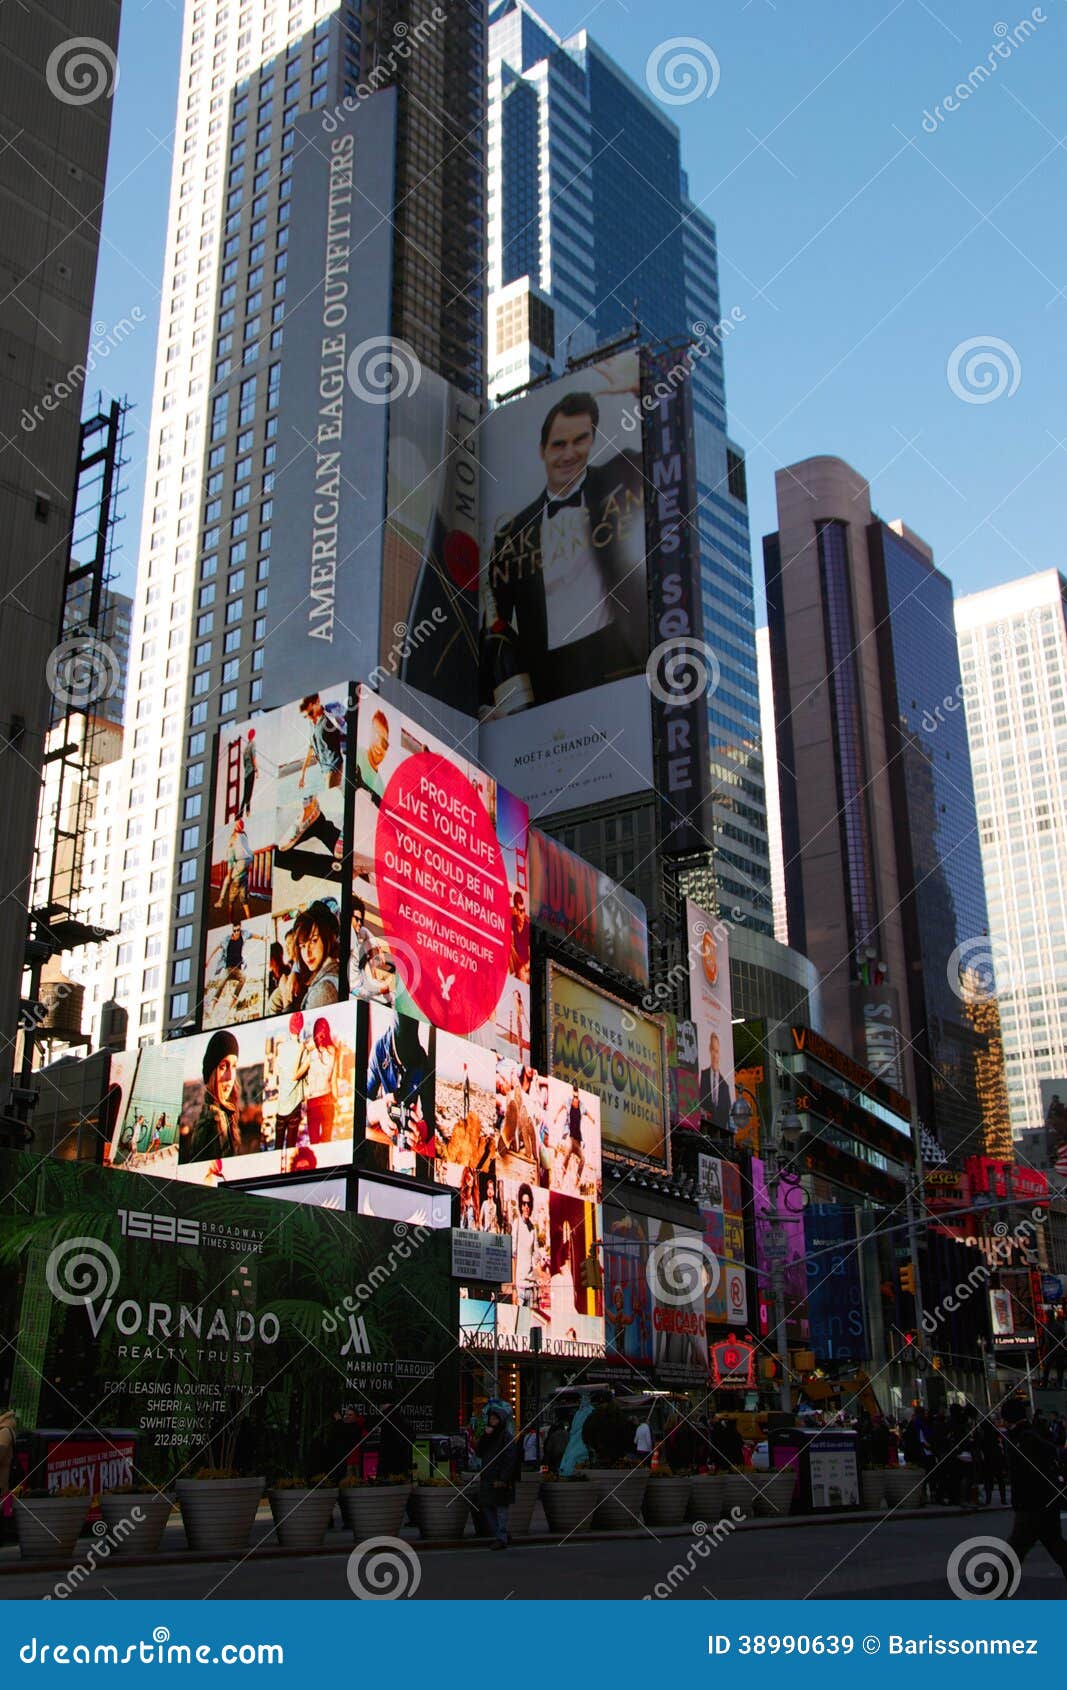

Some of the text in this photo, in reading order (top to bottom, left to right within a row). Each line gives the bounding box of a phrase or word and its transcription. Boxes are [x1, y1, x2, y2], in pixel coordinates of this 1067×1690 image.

[308, 134, 355, 644] AMERICAN EAGLE OUTFITTERS
[652, 391, 683, 554] TIMES
[553, 731, 608, 755] CHANDON
[421, 777, 477, 828] PROJECT
[399, 787, 495, 865] LIVE YOUR LIFE
[396, 831, 494, 904] YOU COULD BE IN
[384, 851, 506, 934] OUR NEXT CAMPAIGN
[398, 903, 495, 964] AE.COM/LIVEYOURLIFE
[416, 932, 478, 974] STARTING 2/10
[553, 1022, 660, 1109] MOTOWN
[628, 1038, 657, 1064] MUSIC
[117, 1208, 264, 1246] 1535 BROADWAY
[202, 1236, 264, 1254] TIMES SQUARE
[83, 1296, 281, 1345] VORNADO
[653, 1306, 706, 1338] CHICAGO
[118, 1345, 253, 1364] REALTY TRUST
[554, 1339, 607, 1360] OUTFITTERS
[345, 1378, 393, 1391] NEW YORK
[346, 1361, 434, 1377] MARRIOTT MARQUIS
[104, 1381, 126, 1395] FOR
[128, 1382, 171, 1396] LEASING
[147, 1399, 182, 1412] SHERRI
[400, 1404, 433, 1417] NTRANCE
[100, 1456, 135, 1494] BOYS
